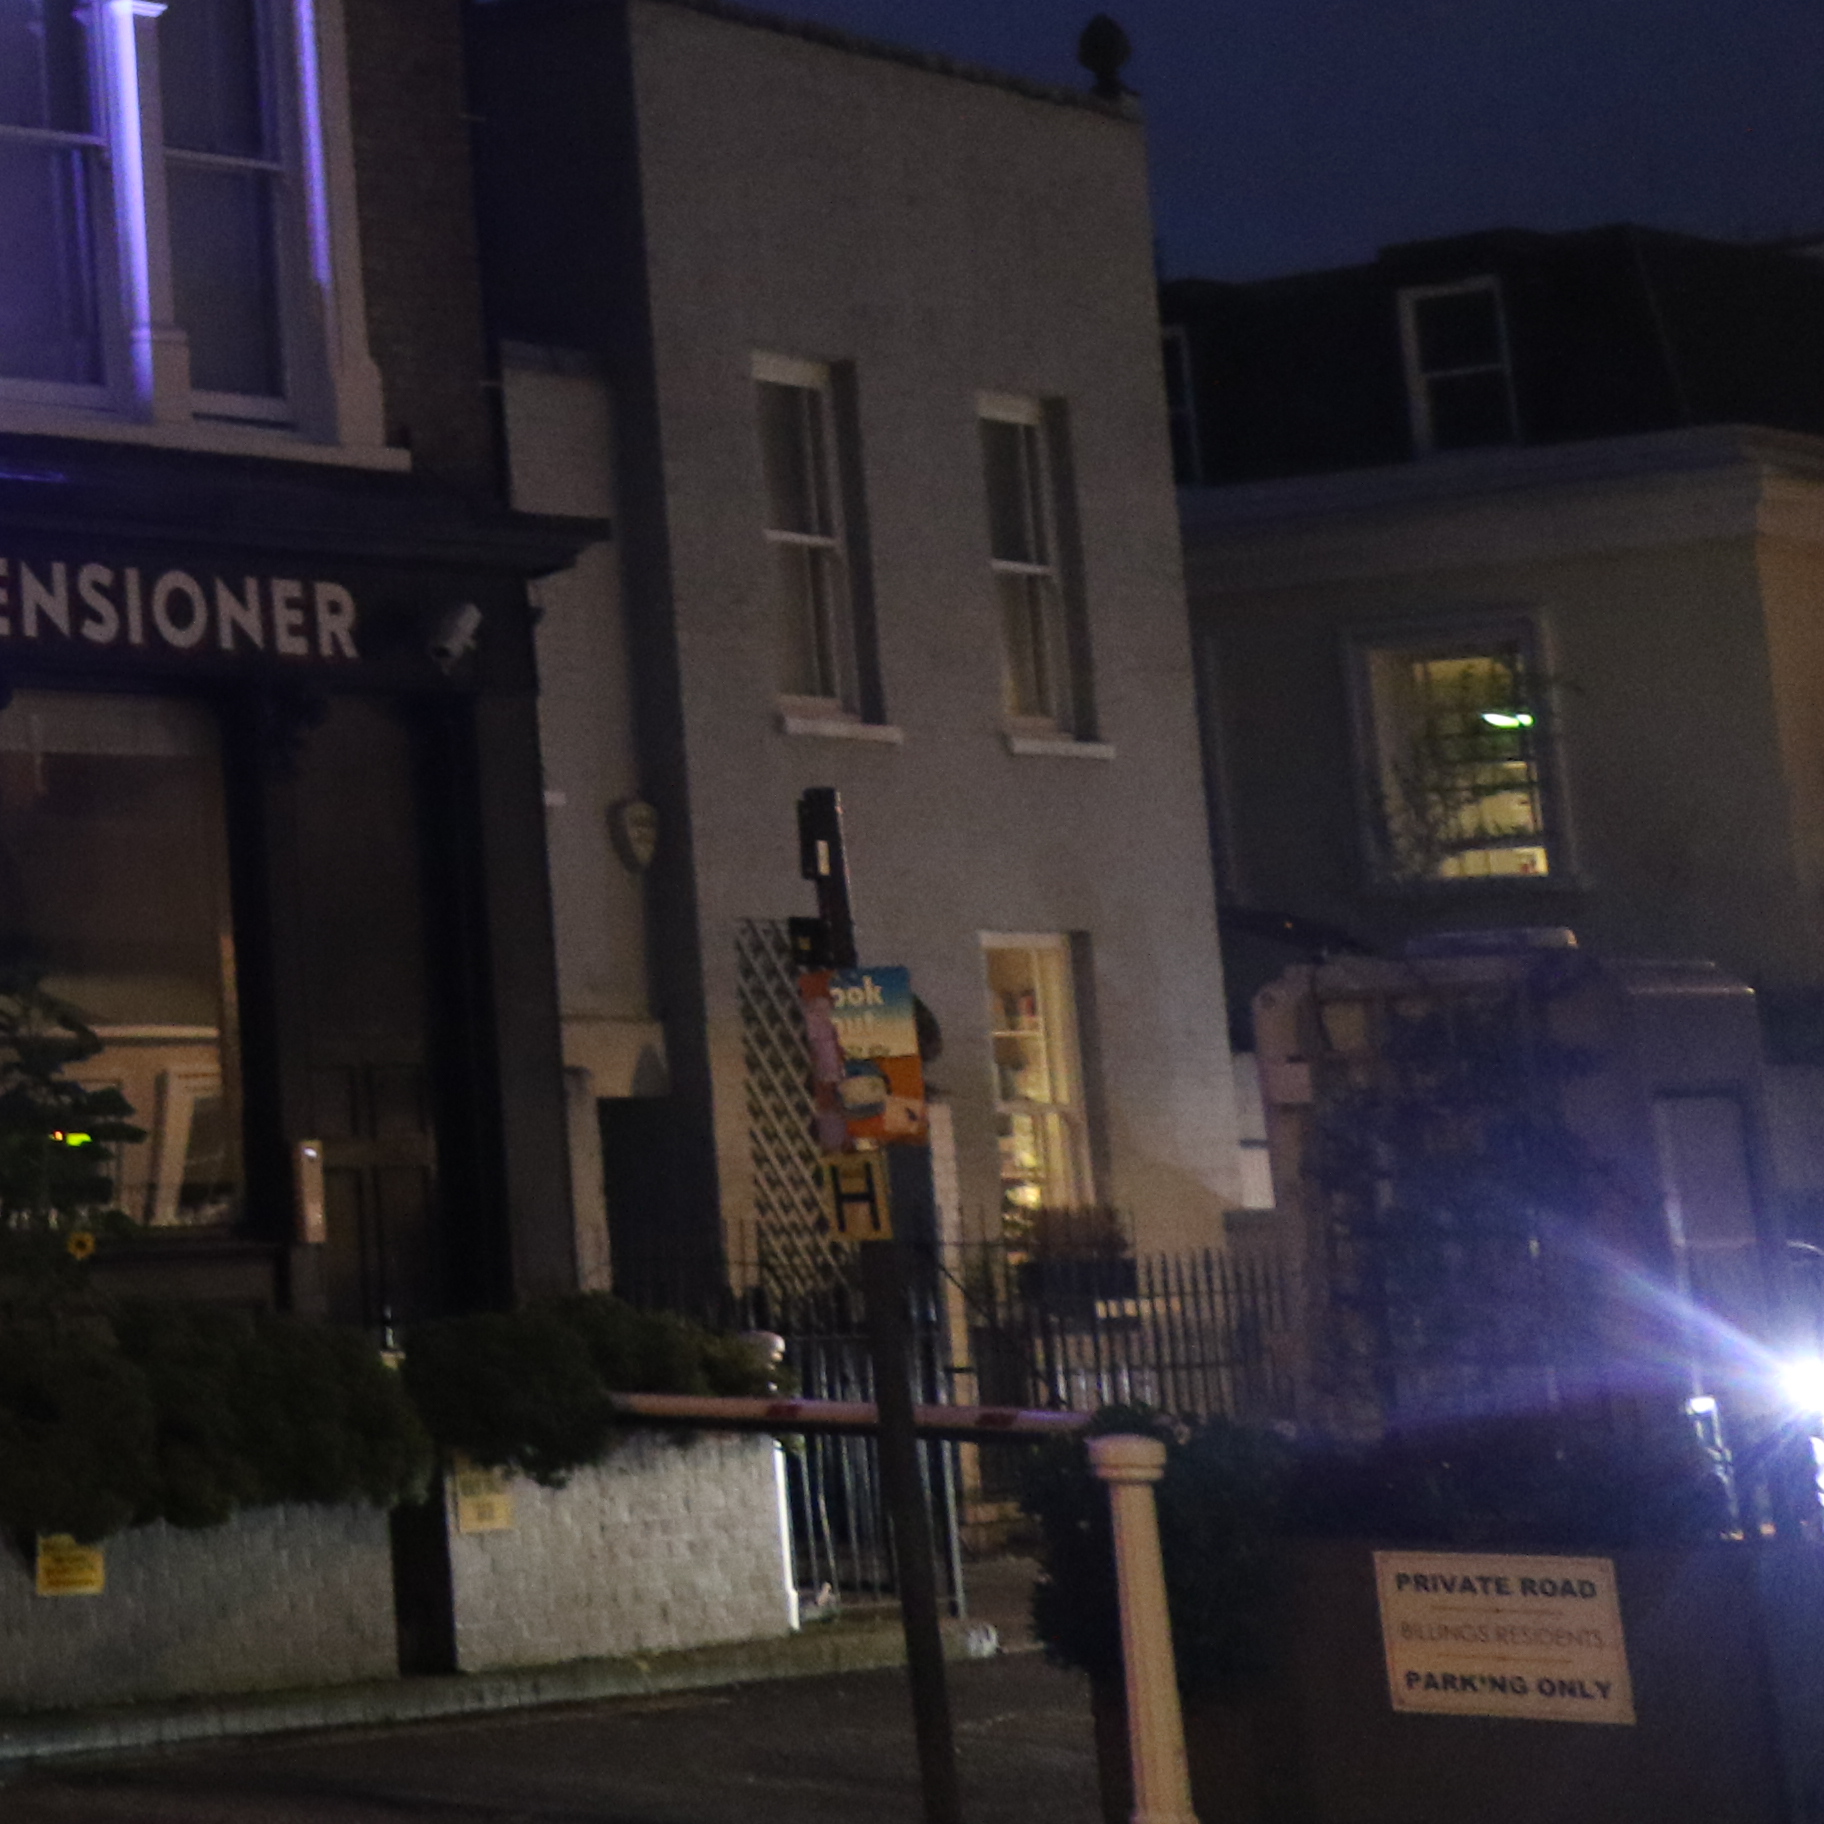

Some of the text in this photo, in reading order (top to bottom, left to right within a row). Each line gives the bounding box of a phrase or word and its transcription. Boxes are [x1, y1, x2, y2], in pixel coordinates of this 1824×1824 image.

[830, 975, 885, 1009] ook
[832, 1161, 882, 1232] H
[1395, 1573, 1598, 1598] PRIVATE ROAD
[1537, 1677, 1613, 1699] ONLY
